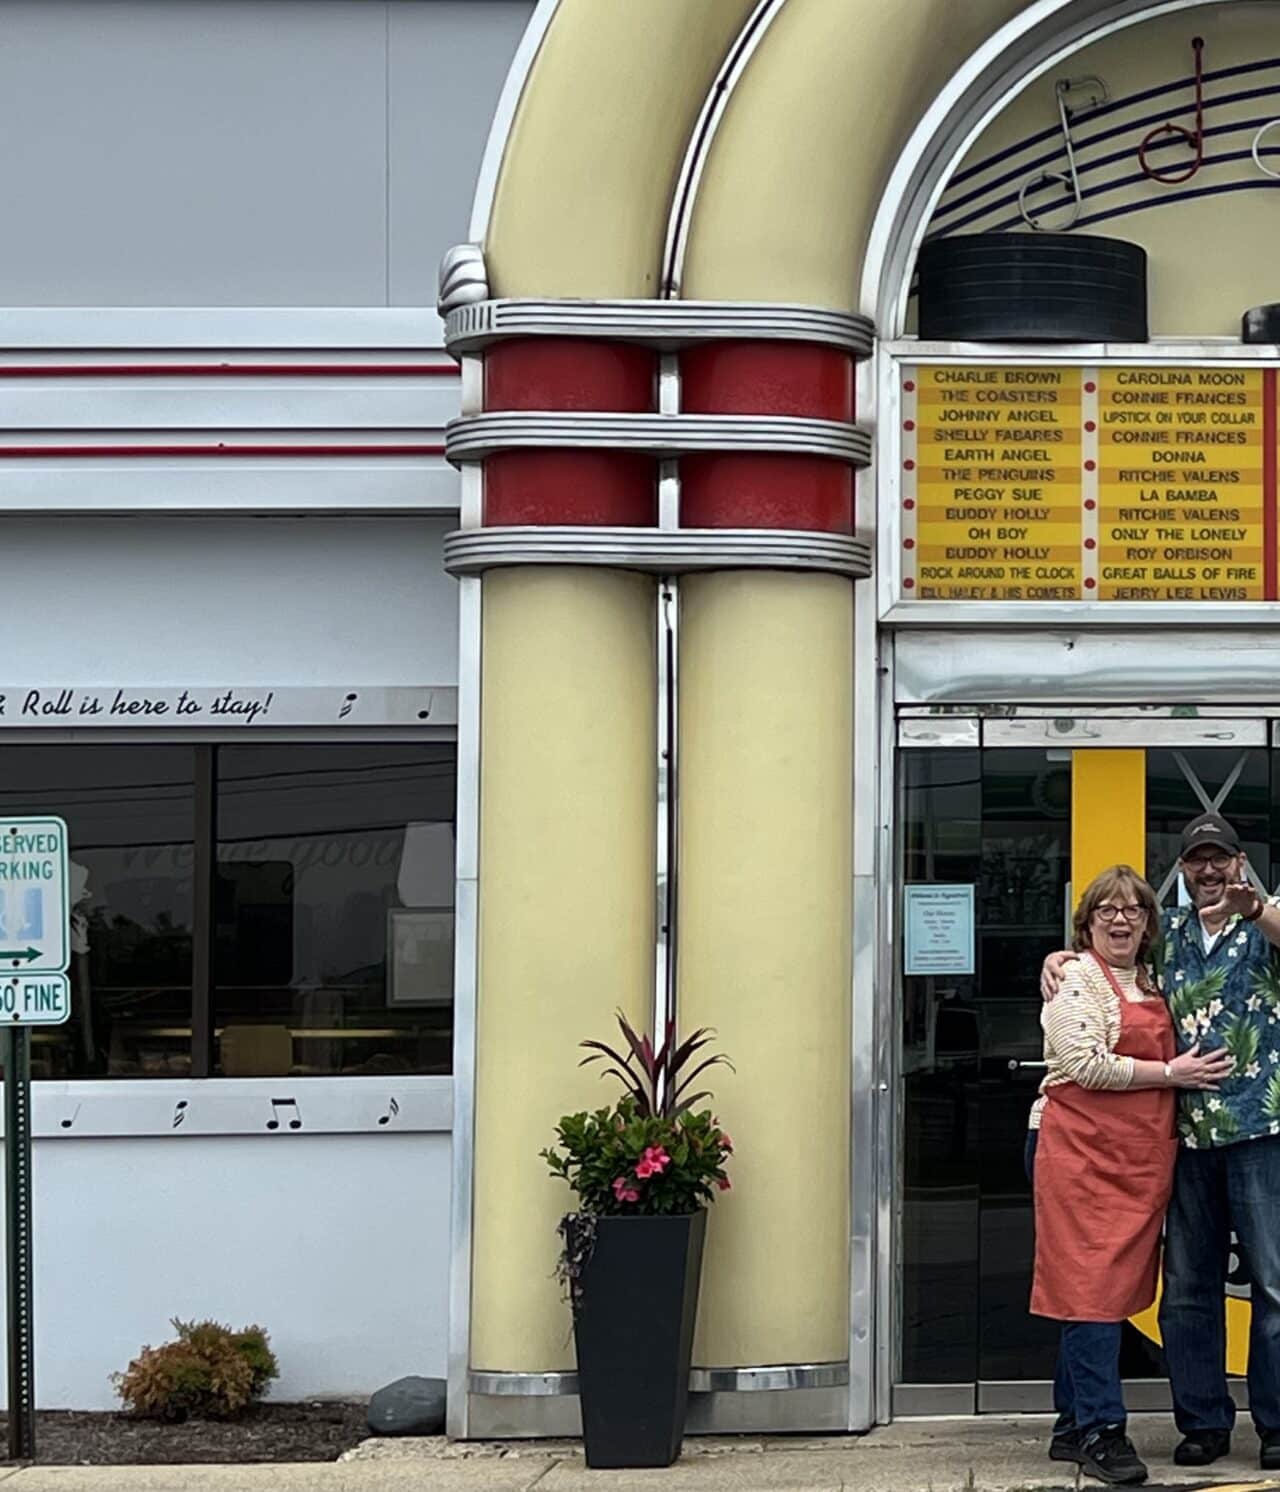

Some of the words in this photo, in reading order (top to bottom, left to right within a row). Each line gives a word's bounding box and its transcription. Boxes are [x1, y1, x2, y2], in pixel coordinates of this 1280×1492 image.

[934, 371, 998, 385] CHARLIE
[1004, 371, 1062, 385] BROWN
[1117, 372, 1192, 385] CAROLINA
[1198, 372, 1245, 385] MOON
[941, 390, 968, 403] THE
[976, 390, 1058, 403] COASTERS
[1112, 392, 1169, 405] CONNIE
[1176, 392, 1247, 405] FRANCES
[938, 409, 1000, 423] JOHNNY
[1007, 409, 1058, 423] ANGEL
[1103, 411, 1151, 424] LIPSTICK
[1155, 411, 1173, 424] ON
[1176, 411, 1207, 424] YOUR
[1210, 411, 1255, 424] COLLAR
[995, 429, 1062, 442] FABARES
[1112, 431, 1168, 444] CONNIE
[1176, 431, 1247, 444] FRANCES
[944, 449, 995, 462] EARTH
[1001, 449, 1051, 462] ANGEL
[1152, 450, 1206, 463] DONNA
[942, 468, 971, 481] THE
[978, 468, 1055, 481] PENGUINS
[1119, 470, 1176, 483] RITCHIE
[1182, 470, 1240, 483] VALENS
[954, 488, 1005, 501] PEGGY
[1012, 488, 1042, 501] SUE
[1140, 489, 1160, 502] LA
[1166, 489, 1218, 502] BAMBA
[945, 507, 997, 520] BUDDY
[1004, 507, 1050, 520] HOLLY
[1119, 508, 1176, 521] RITCHIE
[1182, 508, 1240, 521] VALENS
[968, 527, 991, 540] OH
[997, 527, 1028, 540] BOY
[1111, 528, 1149, 541] ONLY
[1156, 528, 1184, 541] THE
[1190, 528, 1247, 541] LONELY
[945, 547, 997, 560] BUDDY
[1003, 547, 1050, 560] HOLLY
[1126, 548, 1157, 561] ROY
[1163, 548, 1232, 561] ORBISON
[920, 567, 954, 580] ROCK
[957, 567, 1005, 580] AROUND
[1010, 567, 1031, 580] THE
[1035, 567, 1075, 580] CLOCK
[1102, 567, 1148, 580] GREAT
[1153, 567, 1196, 580] BALLS
[1202, 567, 1221, 580] OF
[1226, 567, 1256, 580] FIRE
[1112, 587, 1160, 599] JERRY
[1166, 587, 1194, 599] LEE
[1200, 587, 1247, 599] LEWIS
[22, 689, 71, 716] Roll
[79, 696, 102, 715] is
[110, 689, 169, 715] here
[176, 690, 201, 715] to
[210, 690, 273, 723] stay!
[24, 984, 63, 1012] FINE
